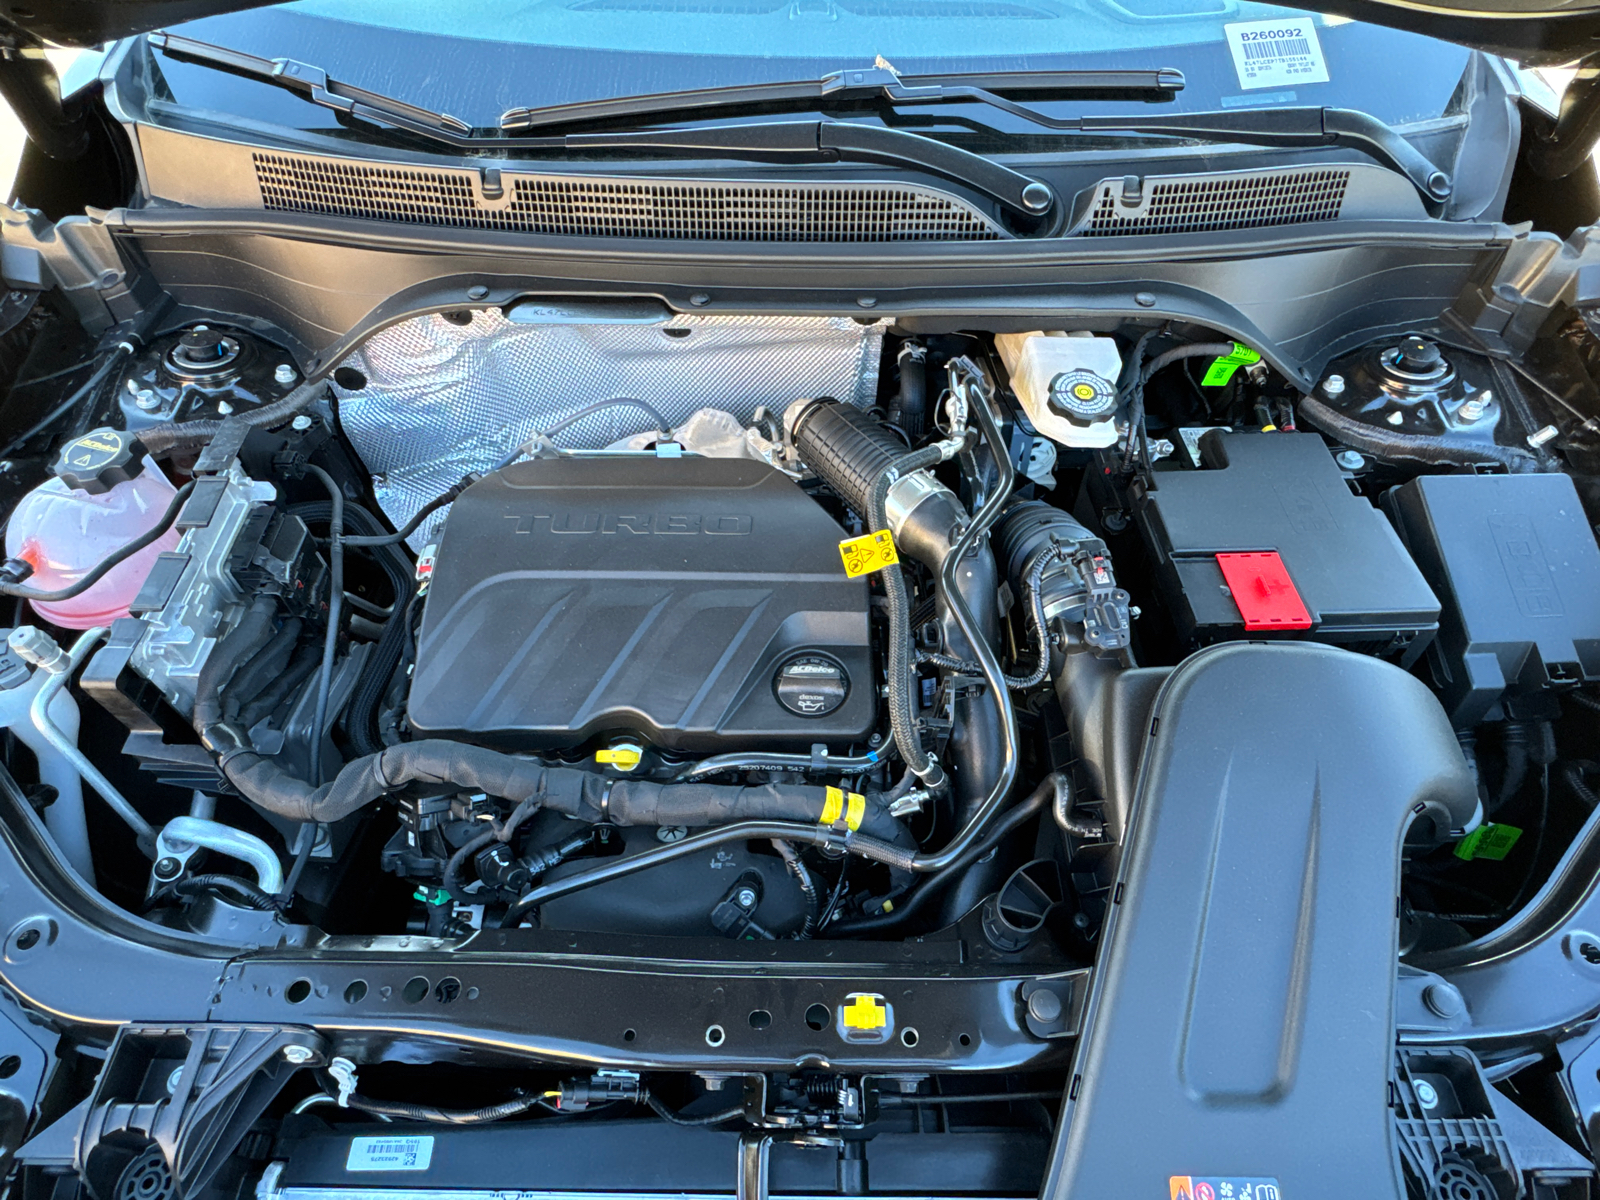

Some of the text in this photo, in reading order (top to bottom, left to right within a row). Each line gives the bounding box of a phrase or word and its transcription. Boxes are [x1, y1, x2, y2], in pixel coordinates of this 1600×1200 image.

[1241, 28, 1303, 41] B260092
[503, 513, 753, 535] TURBO
[789, 665, 835, 674] ACDelco
